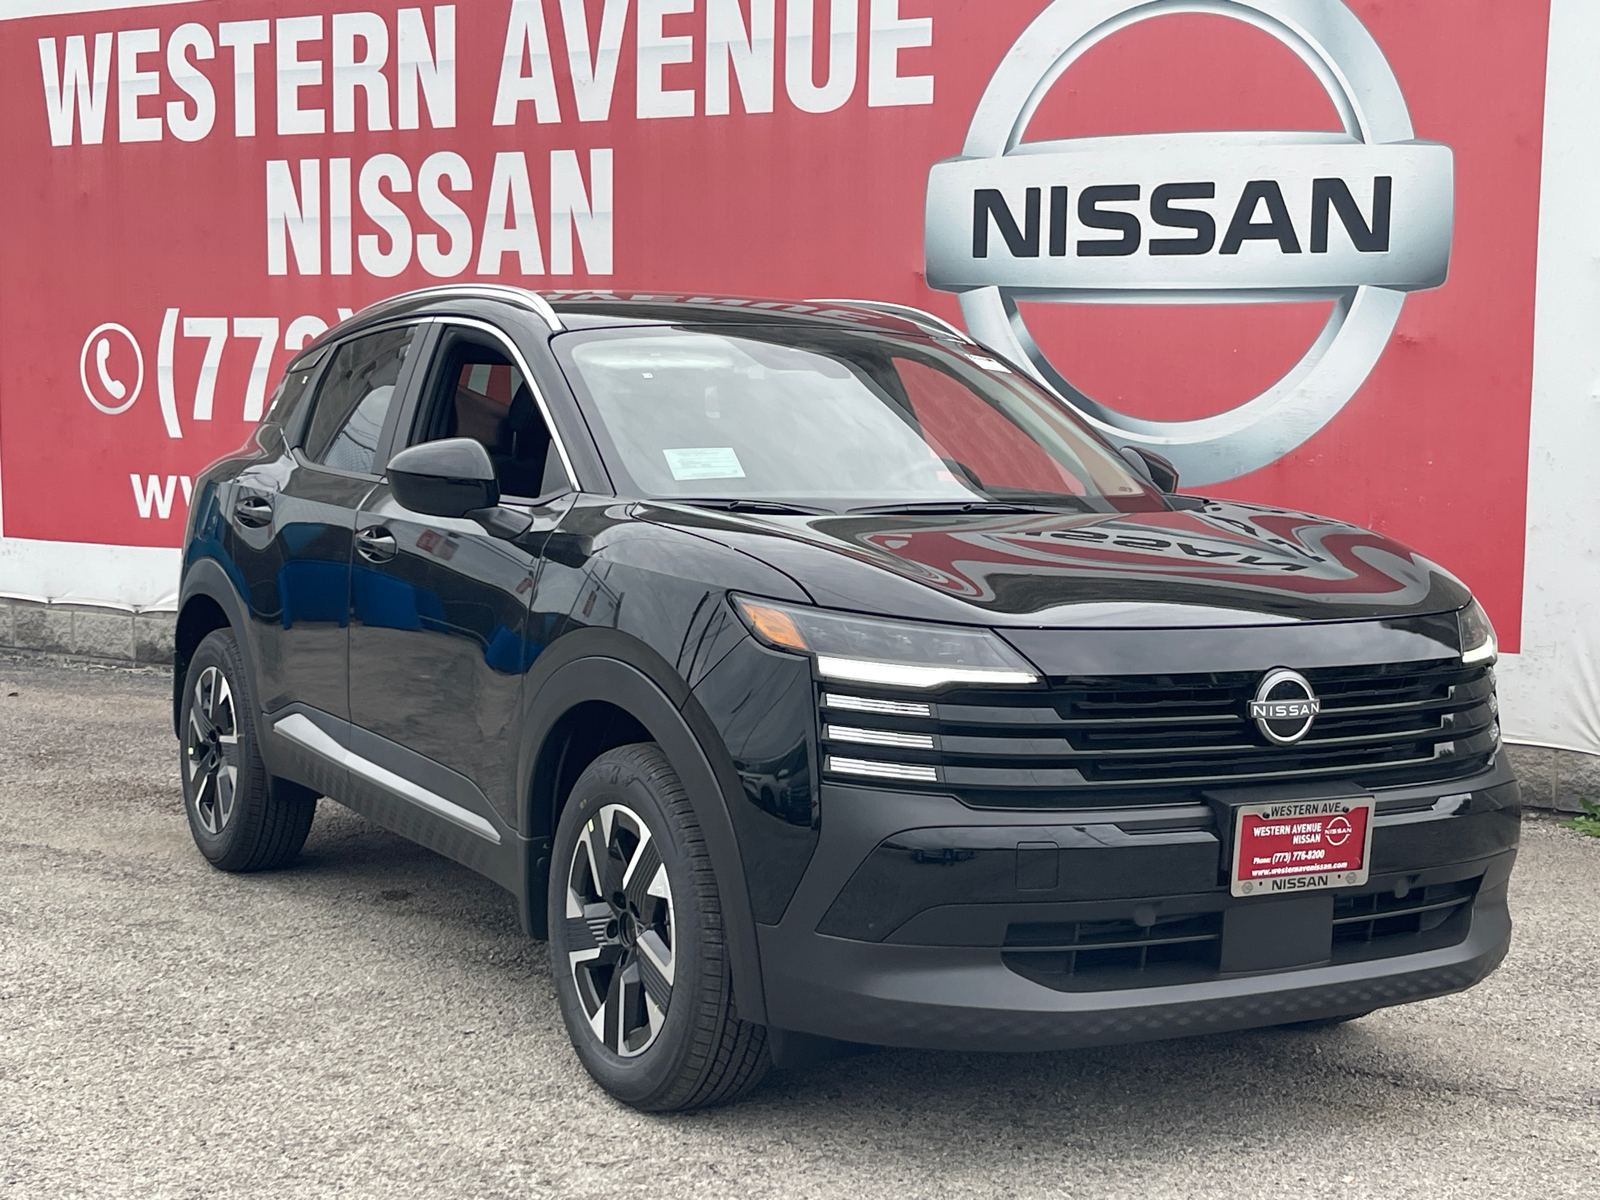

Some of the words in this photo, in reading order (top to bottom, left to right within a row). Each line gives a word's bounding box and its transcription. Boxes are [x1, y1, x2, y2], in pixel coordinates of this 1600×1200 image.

[38, 4, 456, 146] WESTERN
[492, 0, 934, 126] AVENUE
[267, 148, 613, 277] NISSAN
[972, 176, 1391, 258] NISSAN
[1253, 702, 1319, 716] NISSAN
[1271, 804, 1319, 817] WESTERN
[1253, 825, 1291, 837] WESTERN
[1291, 822, 1322, 834] AVENUE
[1292, 833, 1321, 845] NISSAN
[1253, 857, 1271, 865] Phone:
[1272, 852, 1291, 865] (773)
[1292, 849, 1325, 861] 776-8200
[1251, 862, 1348, 876] www.westernavenissan.com
[1272, 875, 1328, 891] NISSAN
